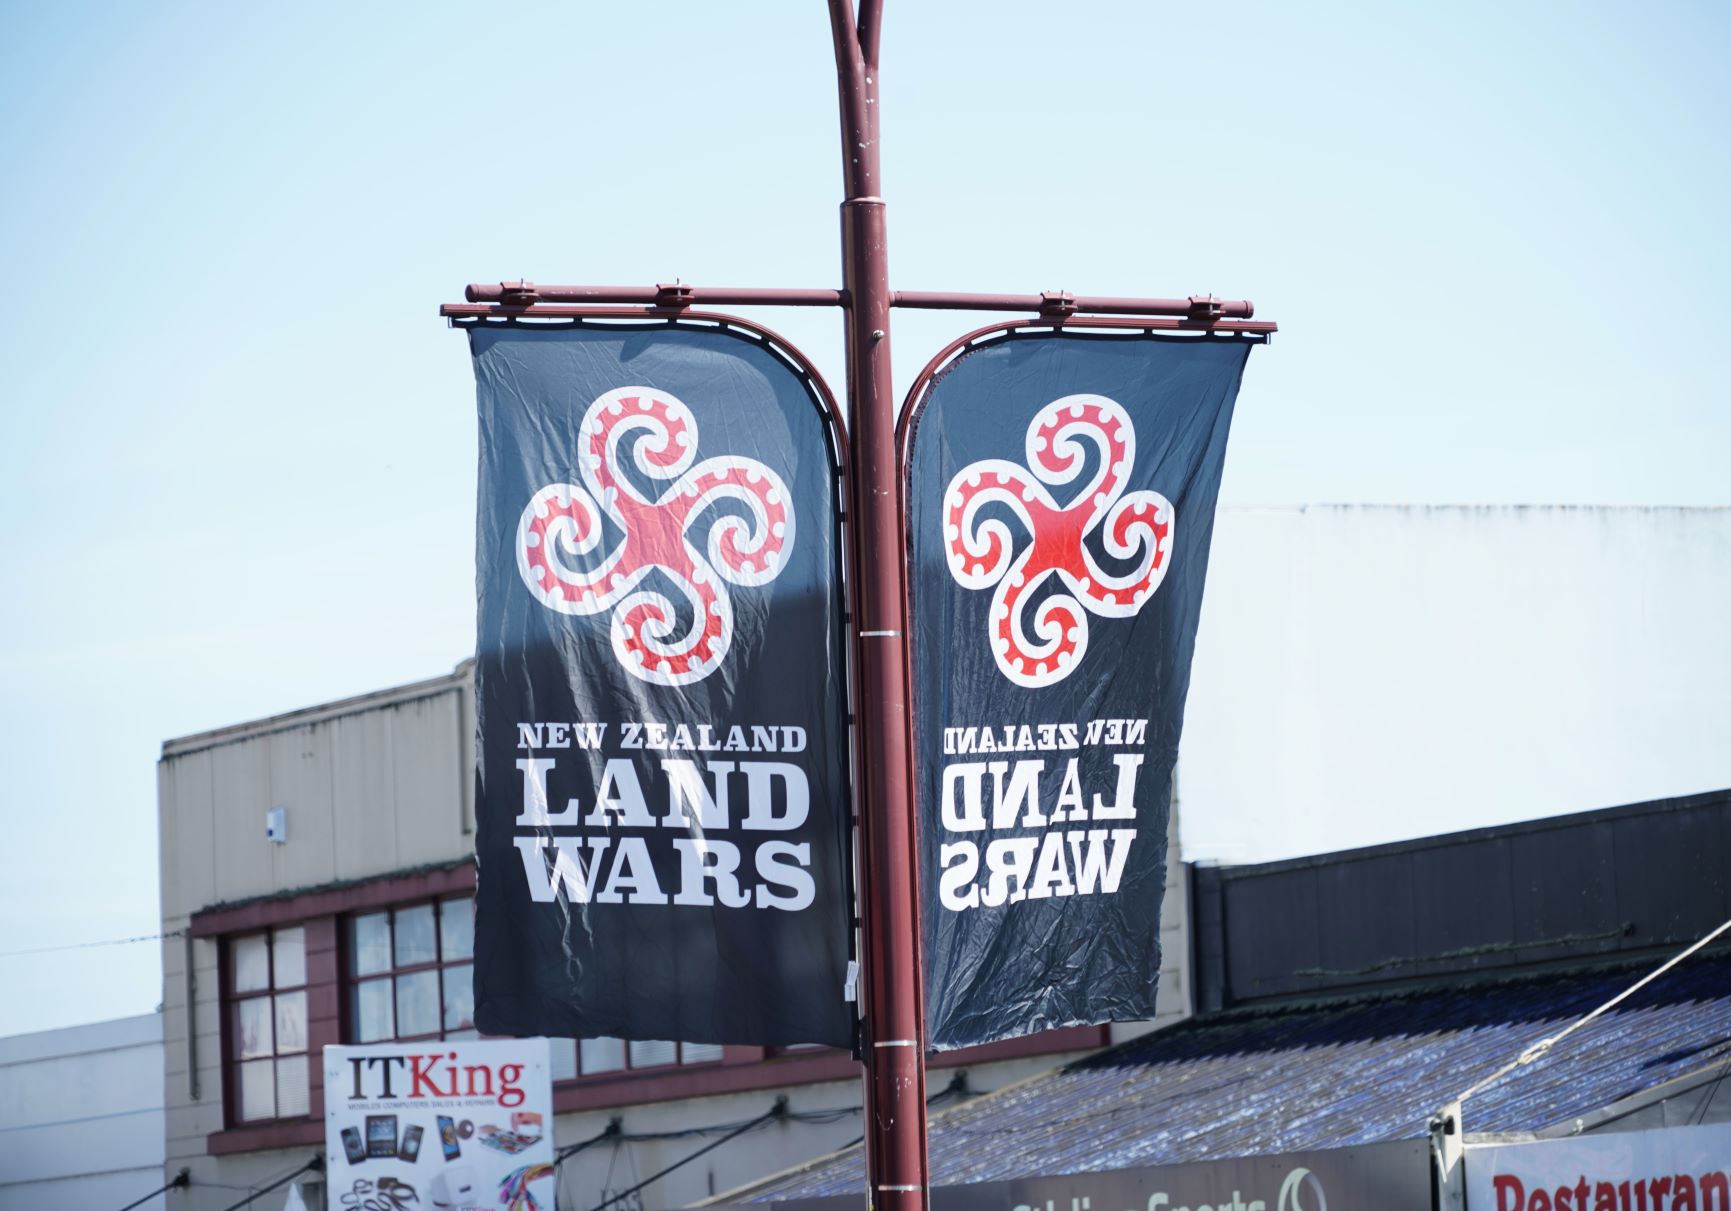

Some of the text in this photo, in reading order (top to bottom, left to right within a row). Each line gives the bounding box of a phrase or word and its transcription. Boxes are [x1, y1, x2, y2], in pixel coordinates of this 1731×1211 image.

[517, 722, 807, 753] NEW ZEALAND
[515, 758, 810, 831] LAND
[513, 836, 816, 911] WARS
[1493, 1171, 1731, 1211] Restauran
